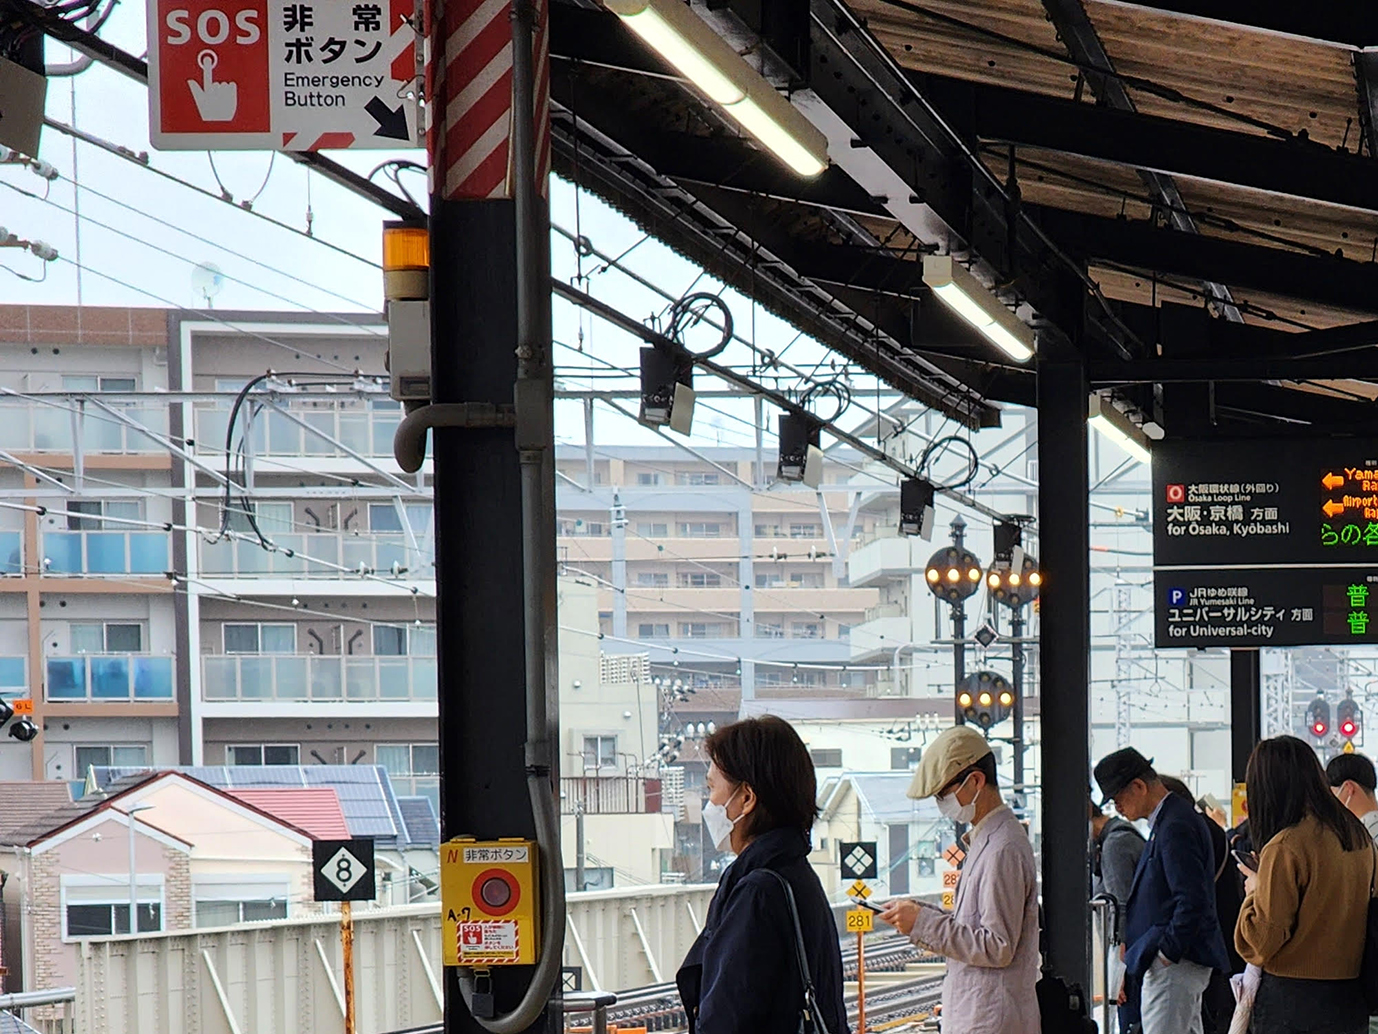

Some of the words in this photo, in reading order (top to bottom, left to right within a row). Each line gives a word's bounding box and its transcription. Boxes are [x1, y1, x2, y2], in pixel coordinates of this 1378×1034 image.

[283, 4, 382, 32] 非常
[166, 8, 261, 45] SOS
[283, 36, 382, 66] ボタン
[283, 72, 384, 89] Emergency
[284, 91, 346, 107] Button
[1214, 494, 1233, 503] Loop
[1234, 494, 1251, 502] Line
[1167, 505, 1244, 522] 大阪・京橋
[1250, 507, 1278, 521] 方面
[1167, 523, 1187, 536] for
[1200, 598, 1237, 606] Yumesaki
[1238, 598, 1255, 606] Line
[1168, 607, 1286, 622] ユニバーサルシティ
[1291, 608, 1314, 622] 方面
[1168, 625, 1188, 638] for
[1190, 624, 1274, 638] Universal-city
[465, 849, 528, 862] 非常ボタン
[336, 857, 353, 882] 8
[944, 873, 957, 886] 28
[848, 915, 870, 927] 281
